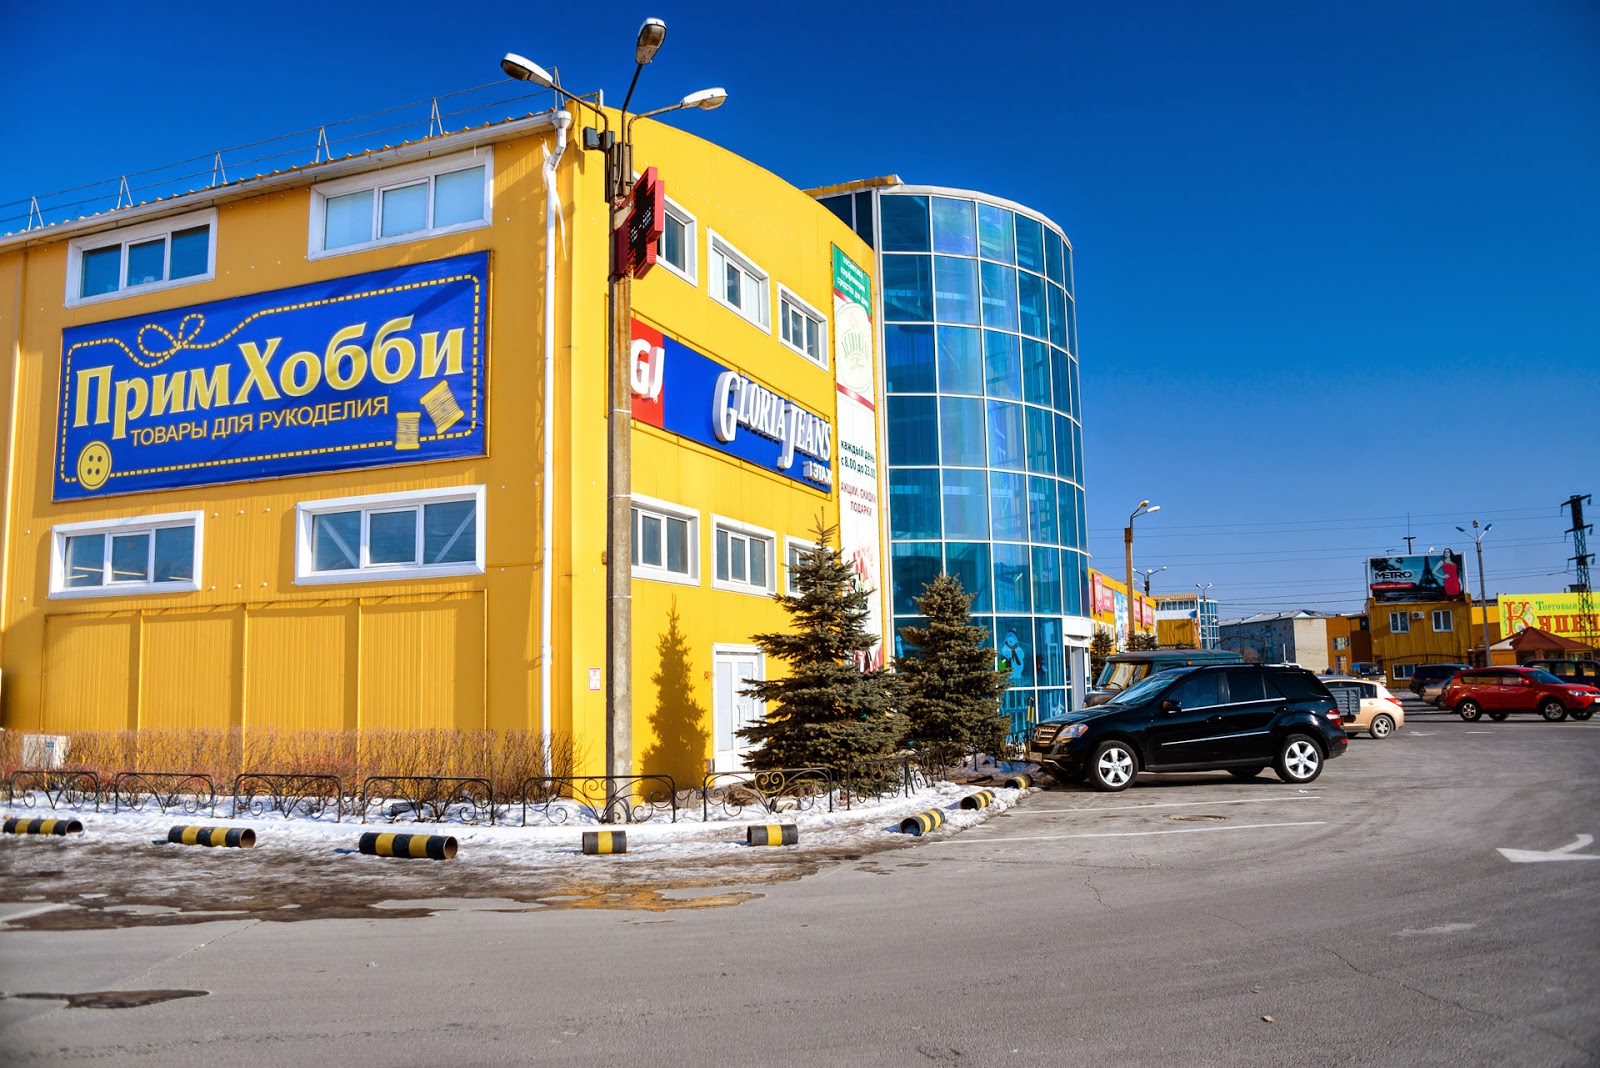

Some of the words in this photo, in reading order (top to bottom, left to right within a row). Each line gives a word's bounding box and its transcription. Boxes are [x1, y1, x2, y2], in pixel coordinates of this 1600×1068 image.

[73, 314, 465, 440] ПримХобби
[130, 420, 208, 448] ТОВАРЫ
[211, 412, 254, 440] ДЛЯ
[259, 395, 389, 430] РУКОДЕЛИЯ
[713, 371, 787, 442] GLORIA
[777, 403, 832, 470] JEANS
[841, 440, 864, 457] каждый
[864, 451, 875, 463] день
[811, 462, 833, 485] ЭТАЖ
[844, 456, 857, 471] 8.00
[857, 463, 864, 475] до
[1374, 571, 1413, 579] METRO
